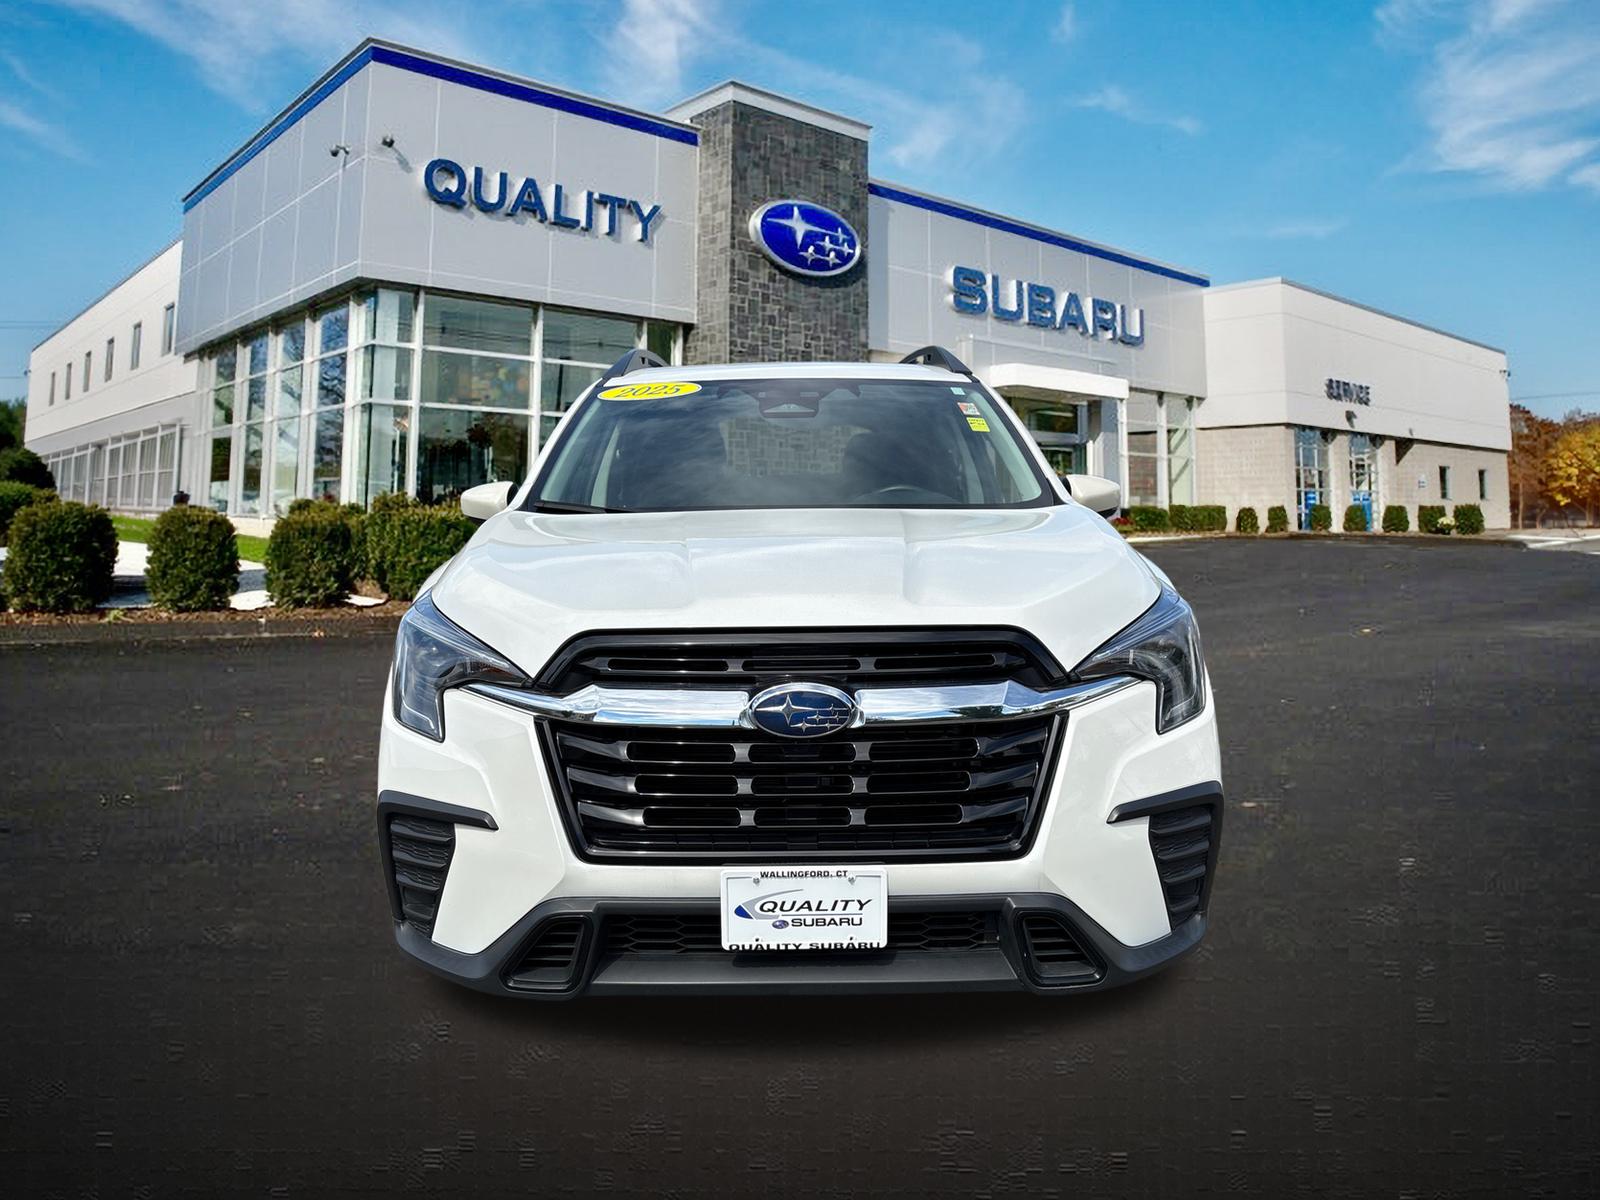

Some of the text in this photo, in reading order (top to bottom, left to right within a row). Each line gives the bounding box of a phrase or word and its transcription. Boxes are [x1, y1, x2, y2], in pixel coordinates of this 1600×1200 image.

[424, 158, 661, 242] QUALITY
[951, 265, 1145, 346] SUBARU
[614, 384, 687, 398] 2025
[759, 899, 873, 913] QUALITY
[791, 917, 863, 927] SUBARU
[729, 942, 881, 951] QUALITY SUBARU
